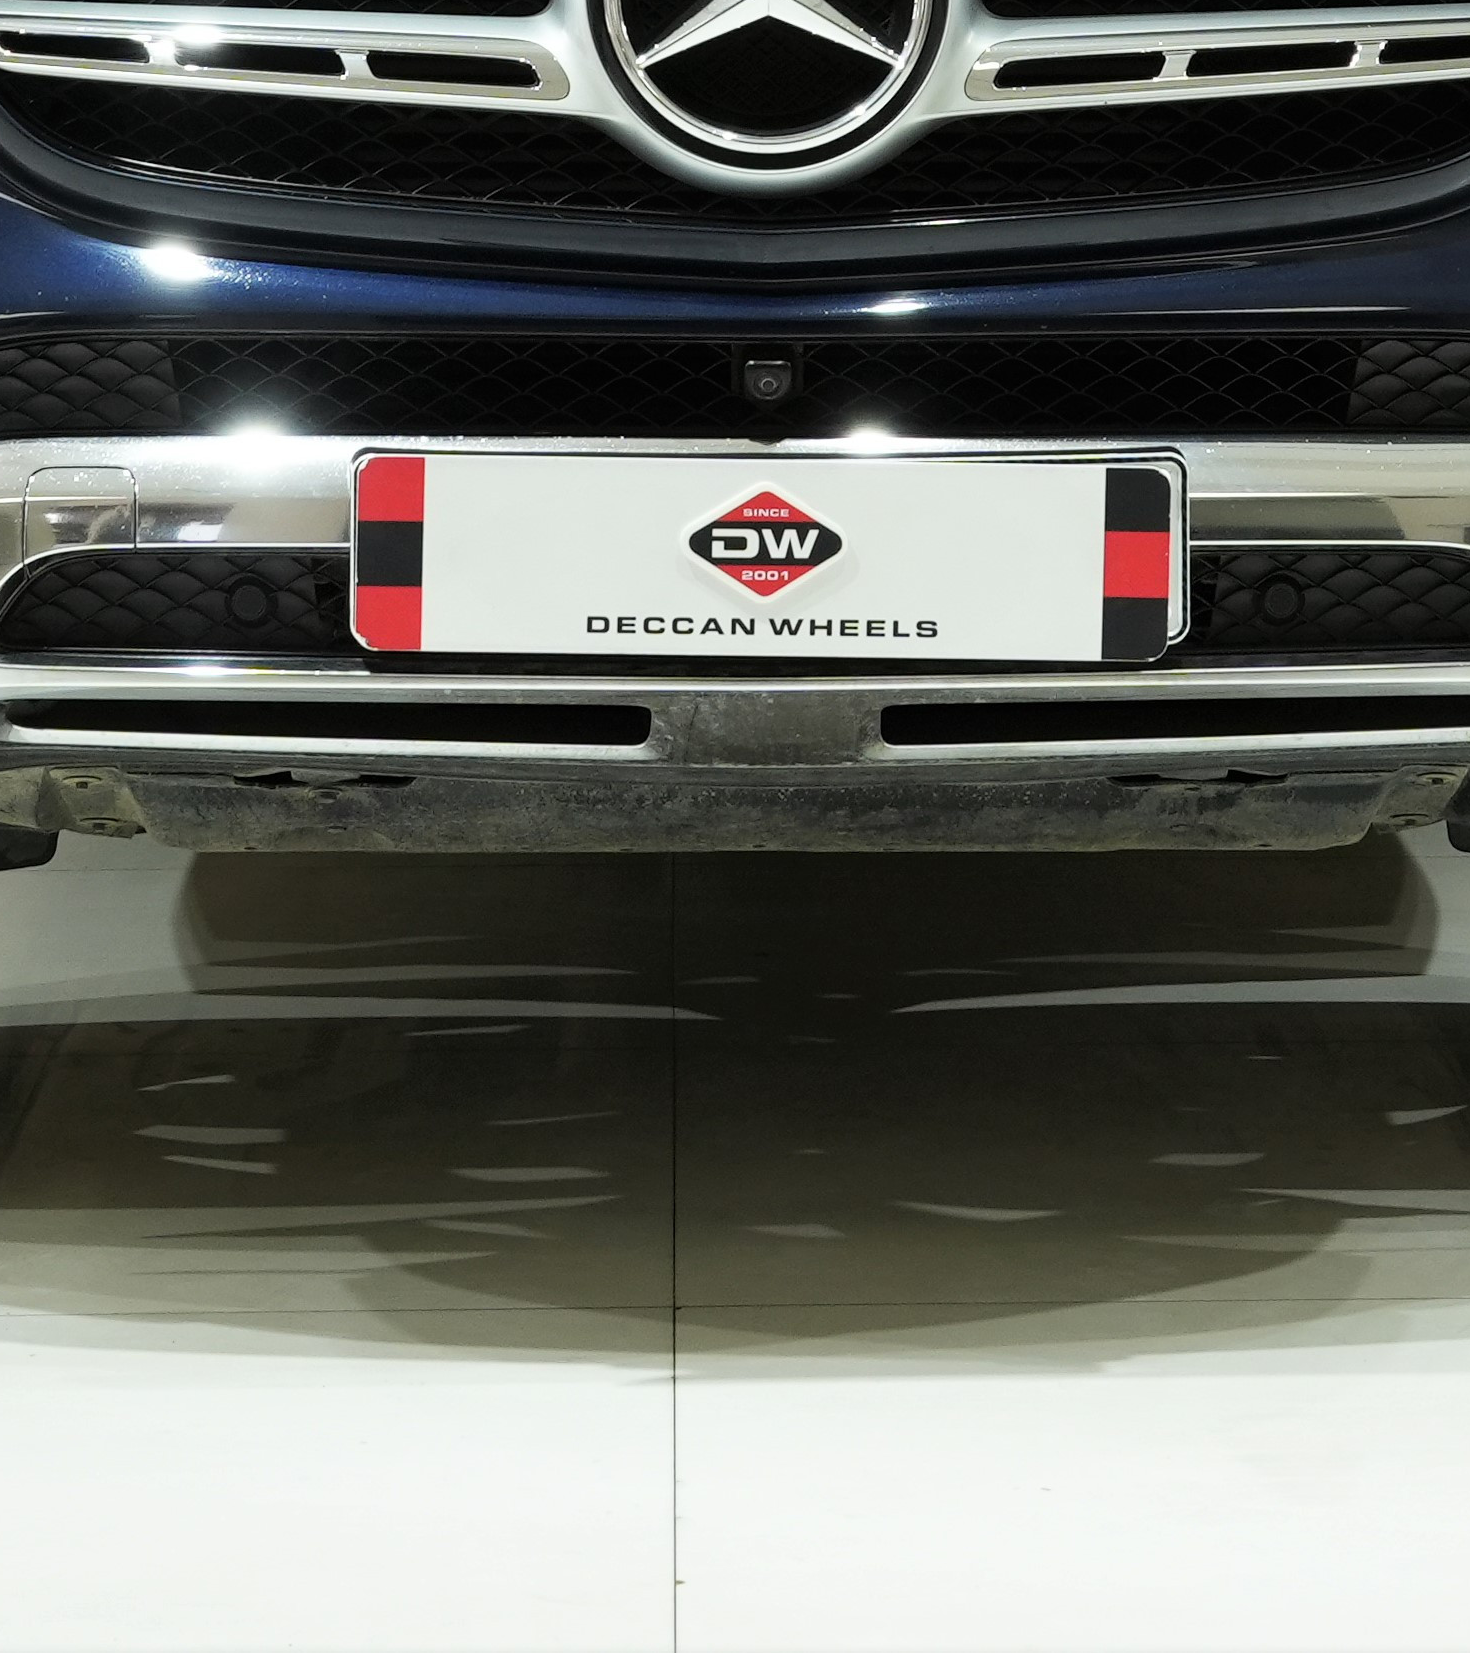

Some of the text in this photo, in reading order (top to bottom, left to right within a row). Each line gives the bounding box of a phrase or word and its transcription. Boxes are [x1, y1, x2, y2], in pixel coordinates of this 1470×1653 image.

[742, 508, 790, 518] SINCE
[711, 528, 820, 560] DW
[741, 570, 790, 581] 2001
[586, 615, 938, 638] DECCAN WHEELS
